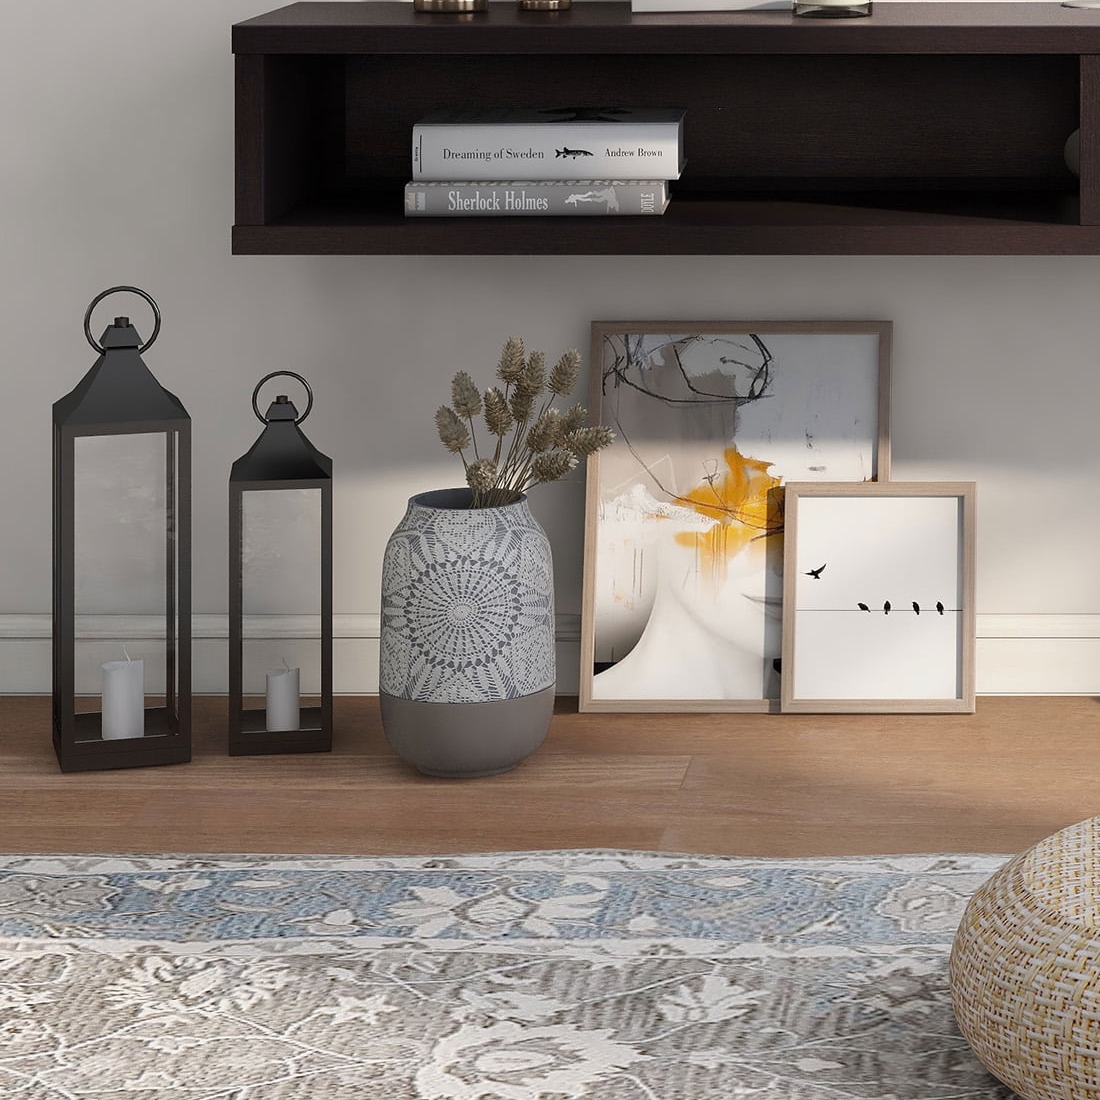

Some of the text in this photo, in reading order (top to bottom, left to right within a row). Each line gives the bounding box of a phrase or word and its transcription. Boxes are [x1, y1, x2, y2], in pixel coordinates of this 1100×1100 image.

[443, 148, 545, 162] Dreaming of Sweden
[605, 147, 663, 157] Andrew Brown
[448, 190, 549, 211] Sherlock Holmes
[640, 193, 655, 213] DOYLE
